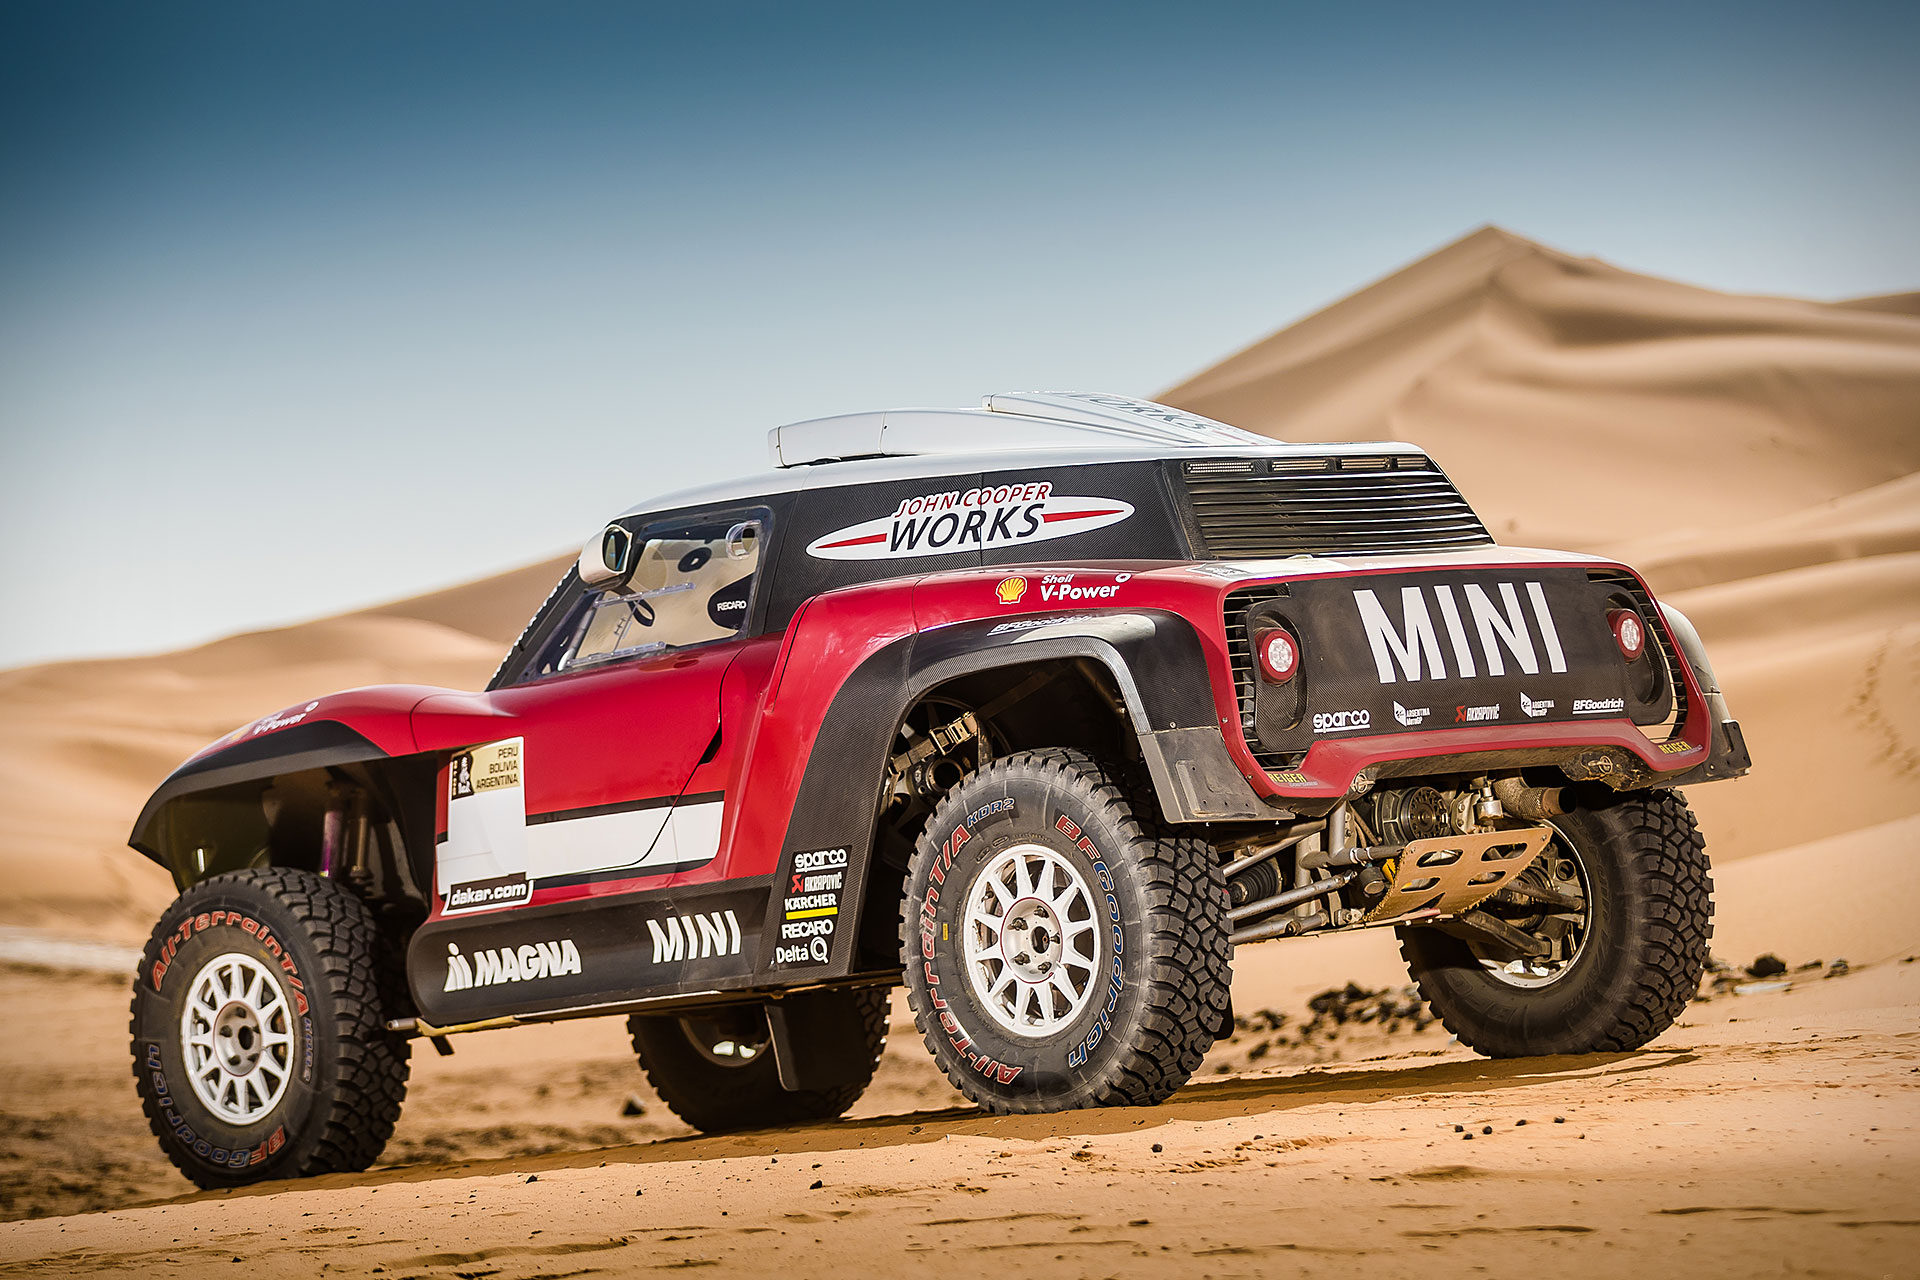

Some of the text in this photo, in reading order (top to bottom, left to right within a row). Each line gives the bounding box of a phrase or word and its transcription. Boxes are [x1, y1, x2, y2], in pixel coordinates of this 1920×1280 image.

[895, 484, 1050, 518] JOHN COOPER
[890, 503, 1046, 552] WORKS
[1041, 573, 1075, 584] Shell
[1040, 584, 1120, 602] V-Power
[716, 600, 747, 612] RECARO
[1352, 581, 1568, 684] MINI
[1572, 697, 1625, 711] BFGoodrich
[1312, 709, 1370, 733] sparco
[497, 745, 519, 760] PERU
[489, 760, 519, 775] BOLIVIA
[475, 773, 519, 789] ARGENTINA
[966, 796, 1015, 829] KDR2
[795, 848, 847, 872] sparco
[450, 882, 527, 907] dakar.com
[646, 909, 742, 965] MINI
[781, 919, 834, 939] RECARO
[775, 943, 810, 964] Delta
[1054, 814, 1125, 1069] BFGoodrich
[473, 939, 583, 988] MAGNA
[148, 1043, 287, 1169] BFGoodrich
